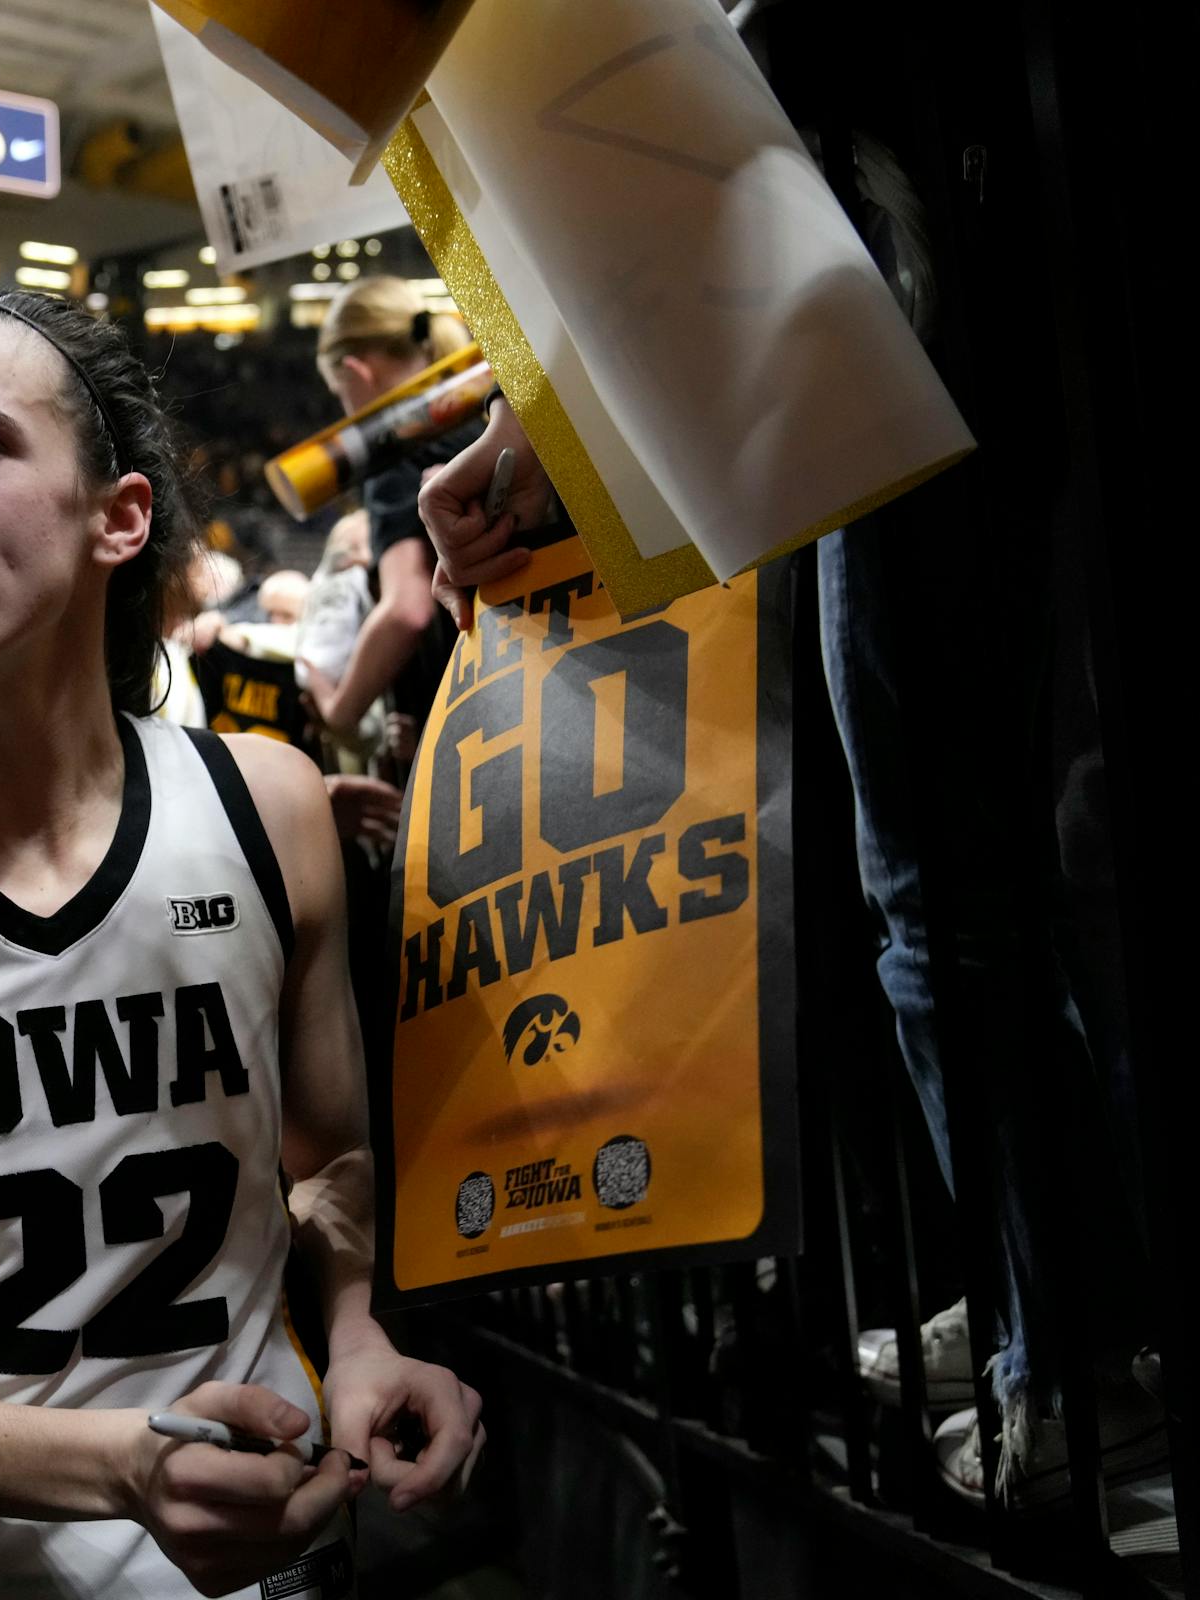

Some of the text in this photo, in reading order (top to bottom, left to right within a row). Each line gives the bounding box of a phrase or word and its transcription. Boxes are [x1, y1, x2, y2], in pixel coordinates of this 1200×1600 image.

[447, 571, 673, 704] LET
[426, 619, 688, 909] GO
[400, 814, 750, 1022] HAWKS
[504, 1158, 556, 1191] FIGHT
[526, 1175, 581, 1209] IOWA
[266, 1561, 317, 1585] ENGINEER
